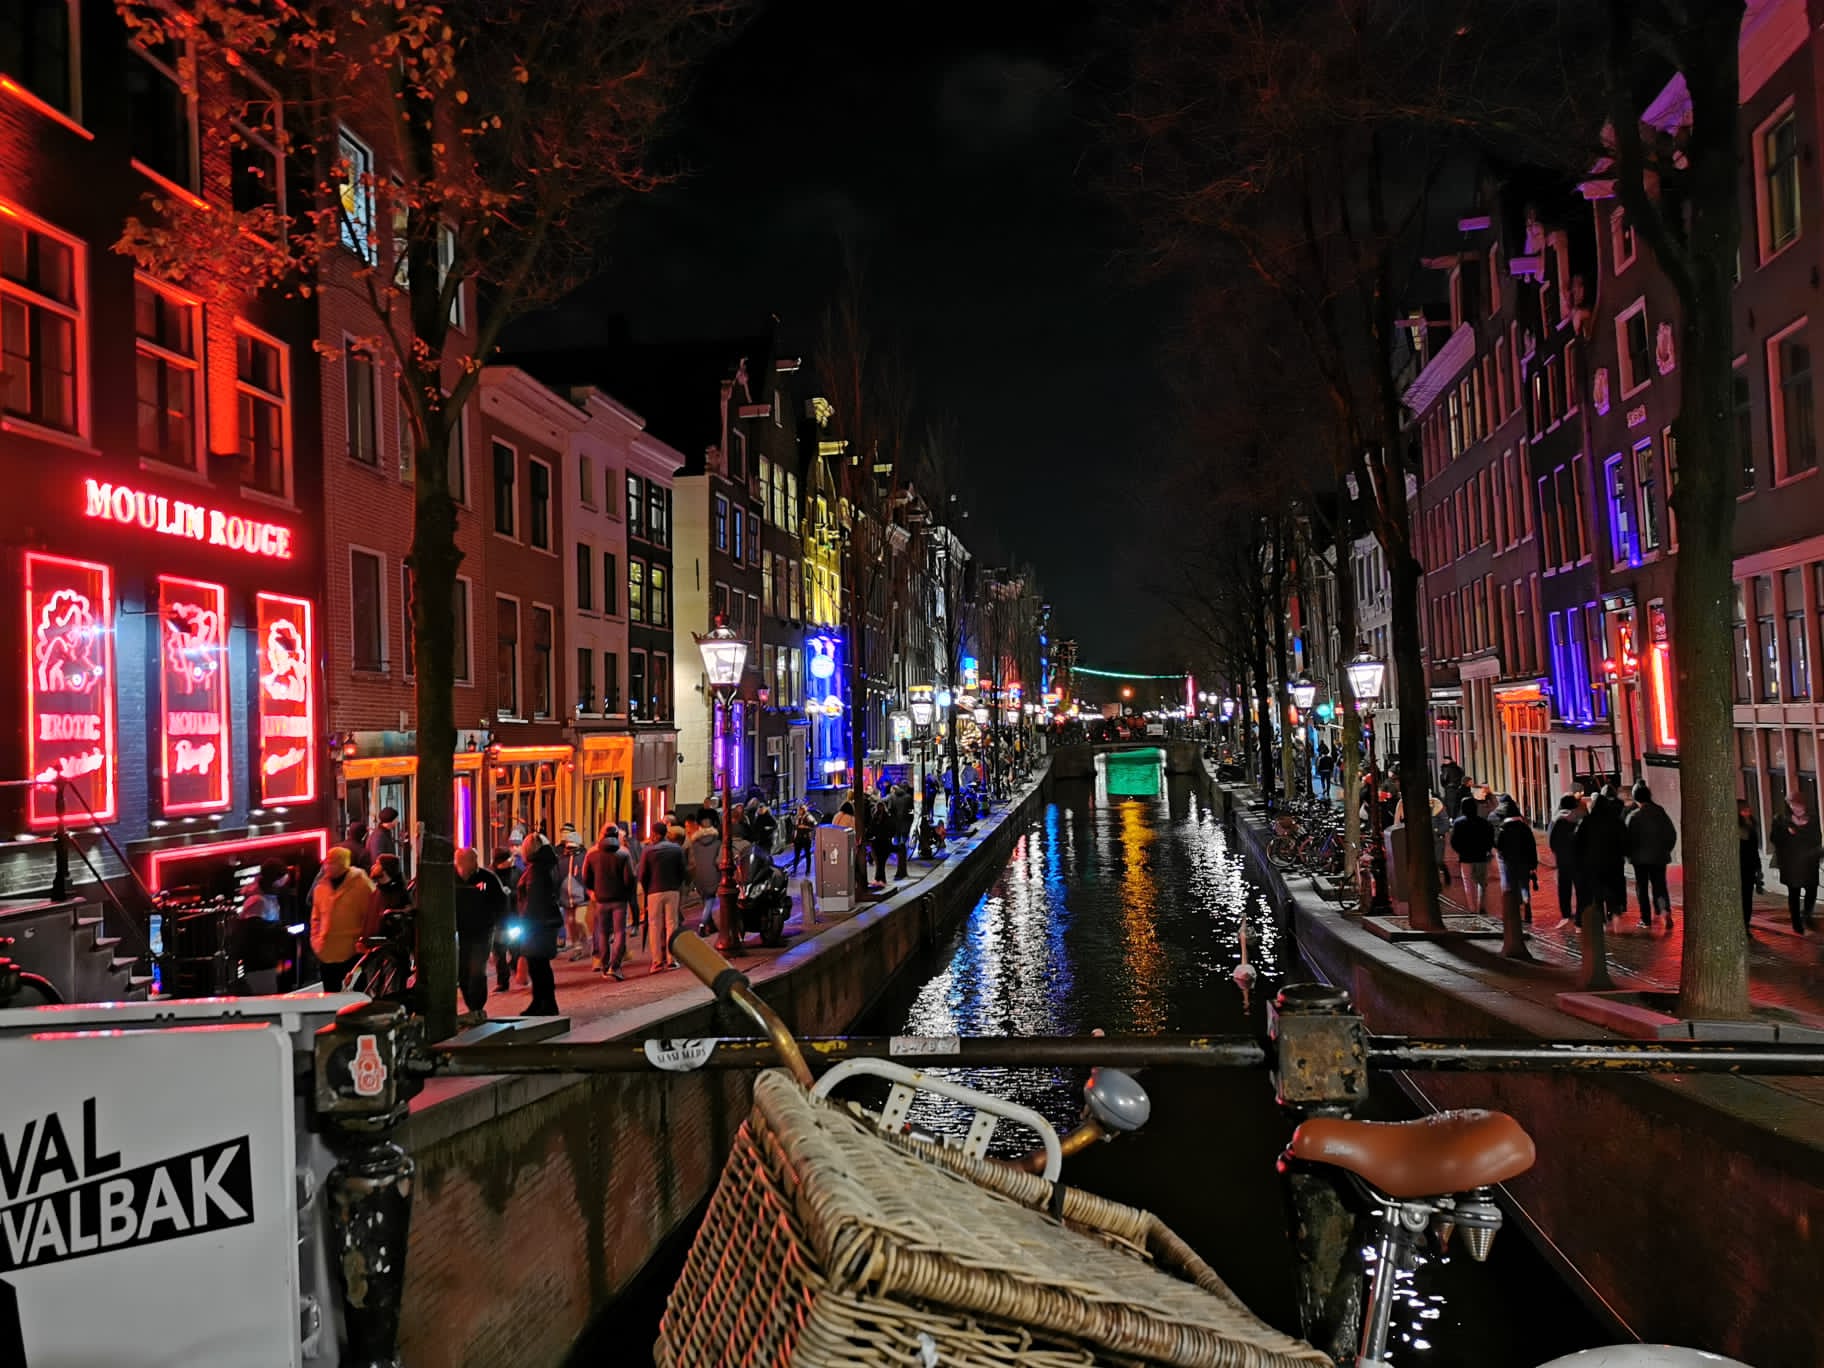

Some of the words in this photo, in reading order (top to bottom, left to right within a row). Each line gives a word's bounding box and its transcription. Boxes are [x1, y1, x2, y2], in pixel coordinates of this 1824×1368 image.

[85, 478, 205, 540] MOULIN
[209, 509, 293, 559] ROUGE
[39, 713, 101, 741] EROTIC
[1, 1144, 250, 1265] VALBAK
